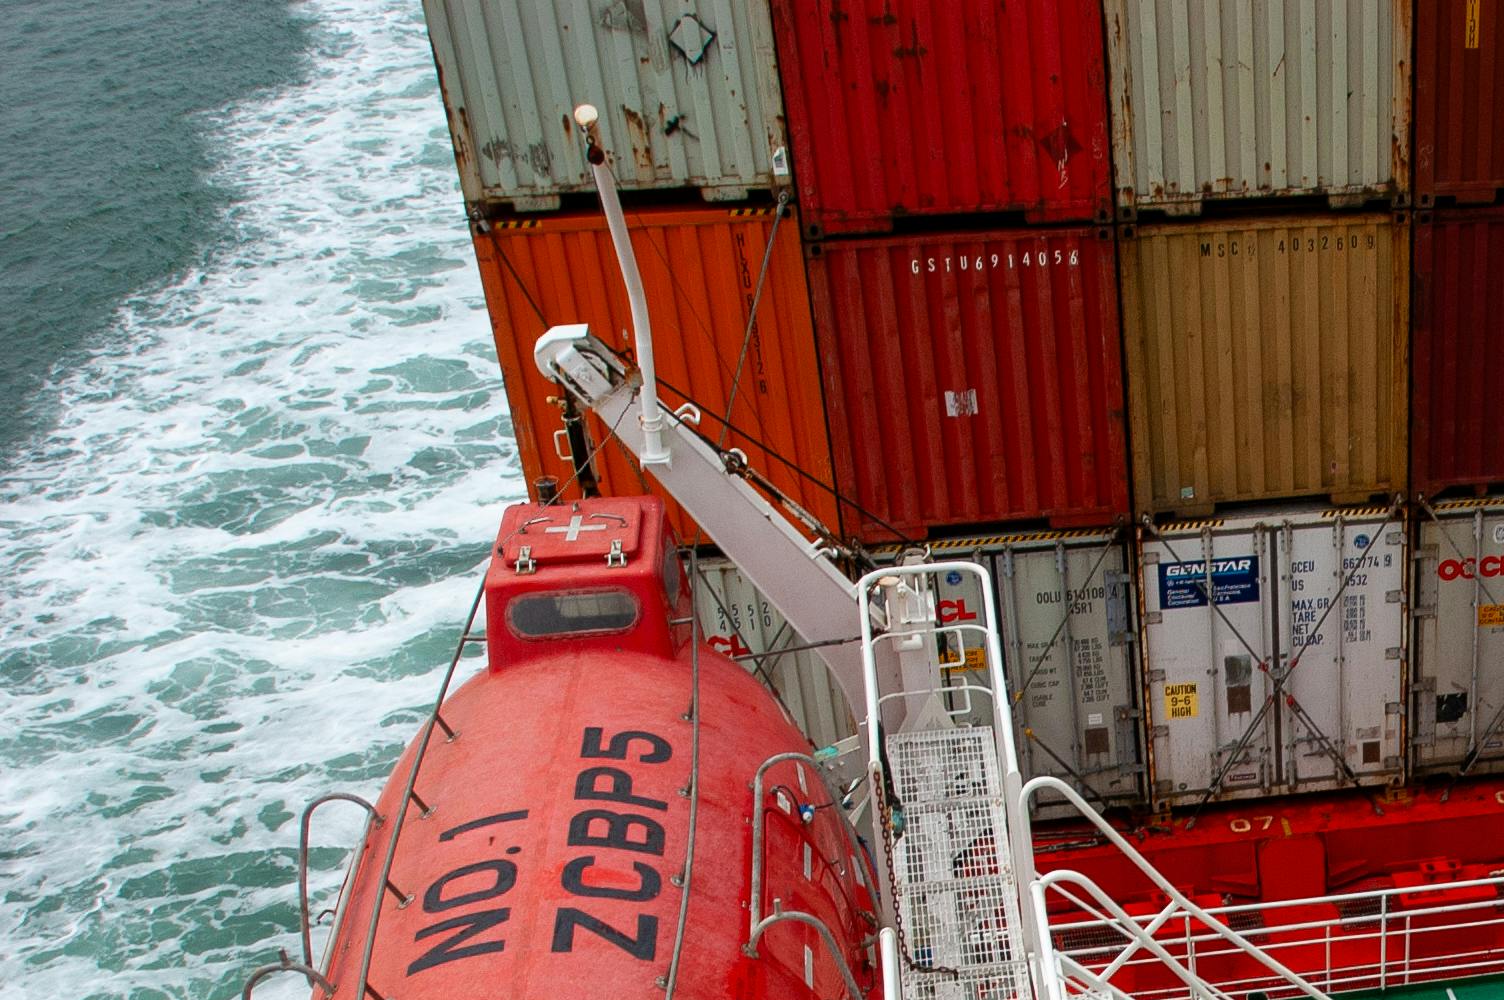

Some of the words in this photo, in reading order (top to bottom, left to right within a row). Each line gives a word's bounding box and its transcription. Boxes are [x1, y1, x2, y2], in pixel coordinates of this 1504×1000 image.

[1278, 235, 1375, 254] 4032609
[911, 250, 1079, 274] GSTU6914056
[1291, 560, 1315, 573] GCEU
[1291, 579, 1304, 592] US
[1036, 591, 1062, 604] OOLU
[1292, 611, 1317, 622] TARE
[1292, 624, 1309, 635] NET
[1165, 684, 1197, 696] CAUTION
[1171, 696, 1191, 706] 9-6
[1171, 706, 1192, 718] HIGH
[551, 727, 673, 961] ZCBP5
[407, 809, 530, 977] NO.1
